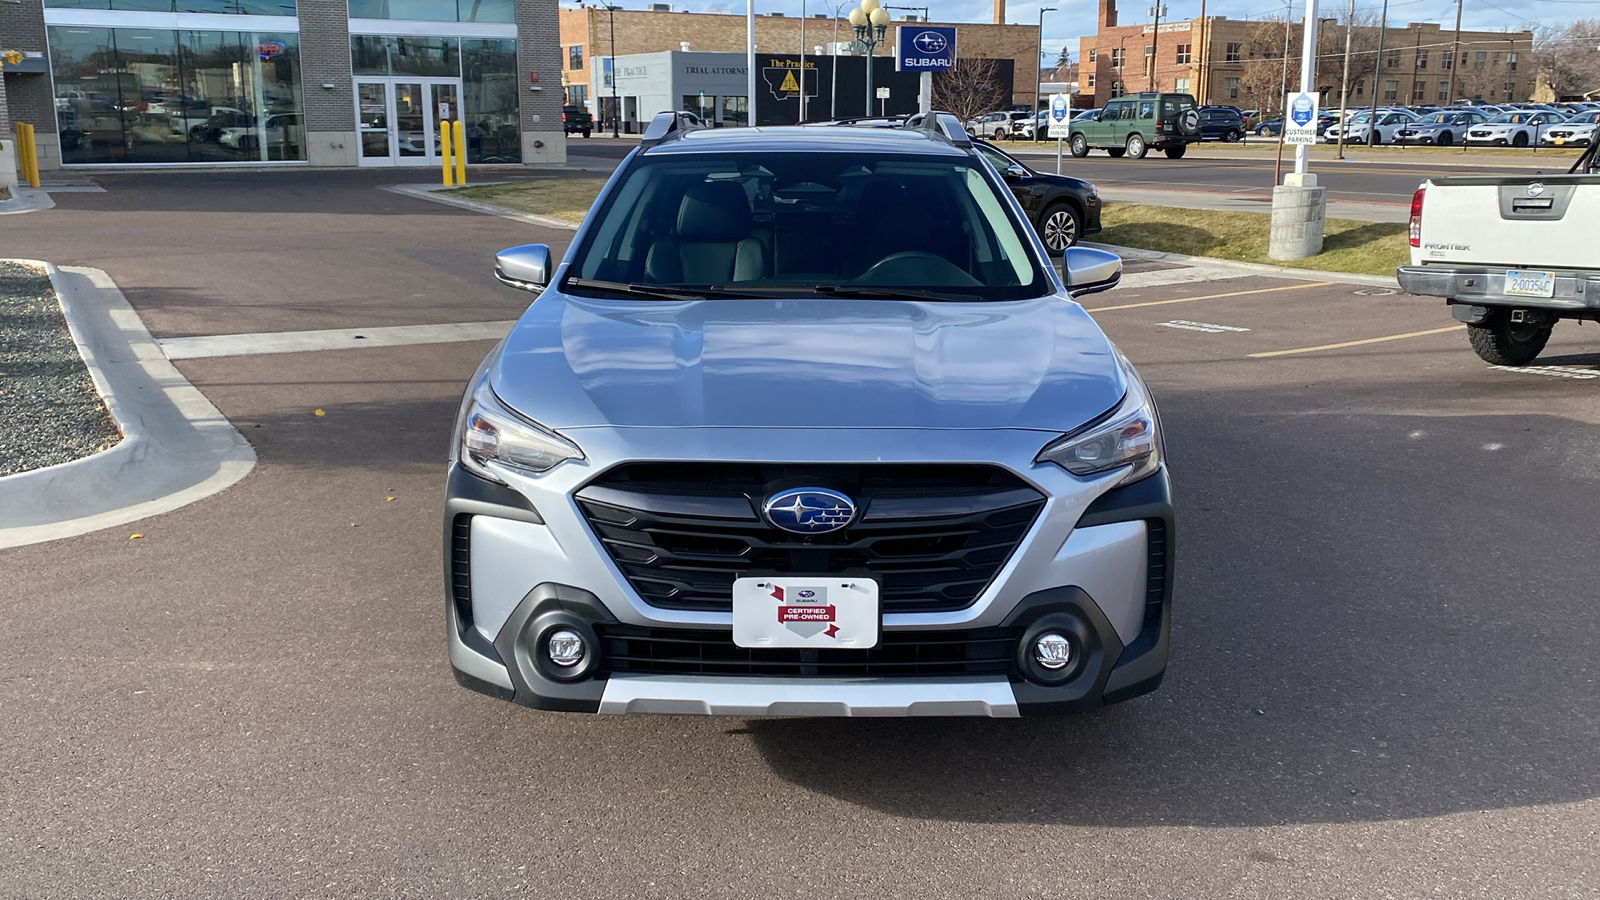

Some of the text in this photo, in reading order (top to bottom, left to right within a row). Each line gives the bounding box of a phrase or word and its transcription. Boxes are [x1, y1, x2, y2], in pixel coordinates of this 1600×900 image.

[257, 44, 283, 54] OPEN
[770, 59, 815, 68] The Pracice
[904, 58, 952, 67] SUBARU
[614, 65, 648, 77] HE PRACTICE
[685, 66, 710, 75] TRIAL
[1286, 128, 1317, 136] CUSTOMER
[1424, 243, 1471, 251] FRONTIER
